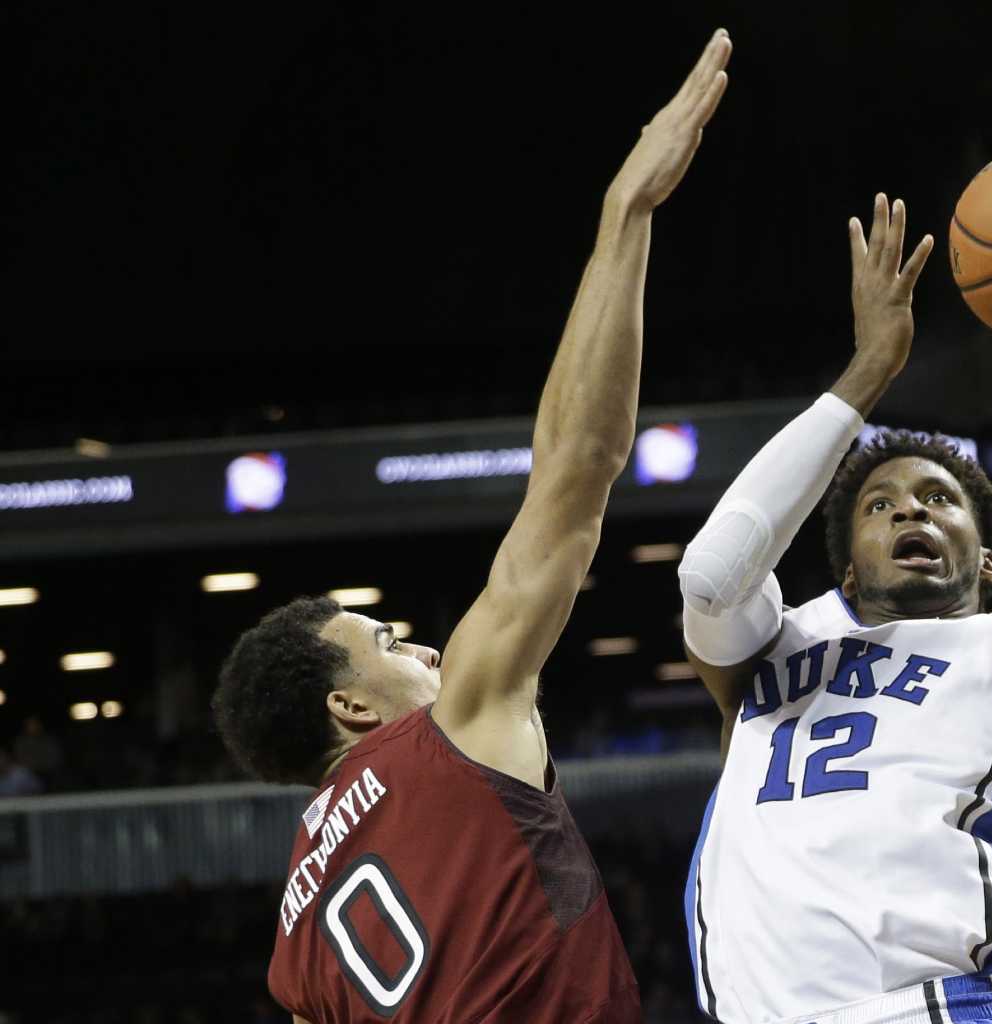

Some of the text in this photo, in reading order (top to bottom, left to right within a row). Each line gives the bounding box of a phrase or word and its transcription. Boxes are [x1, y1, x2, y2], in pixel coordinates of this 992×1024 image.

[741, 637, 951, 723] DUKE
[756, 711, 877, 805] 12
[318, 855, 430, 1016] 0
